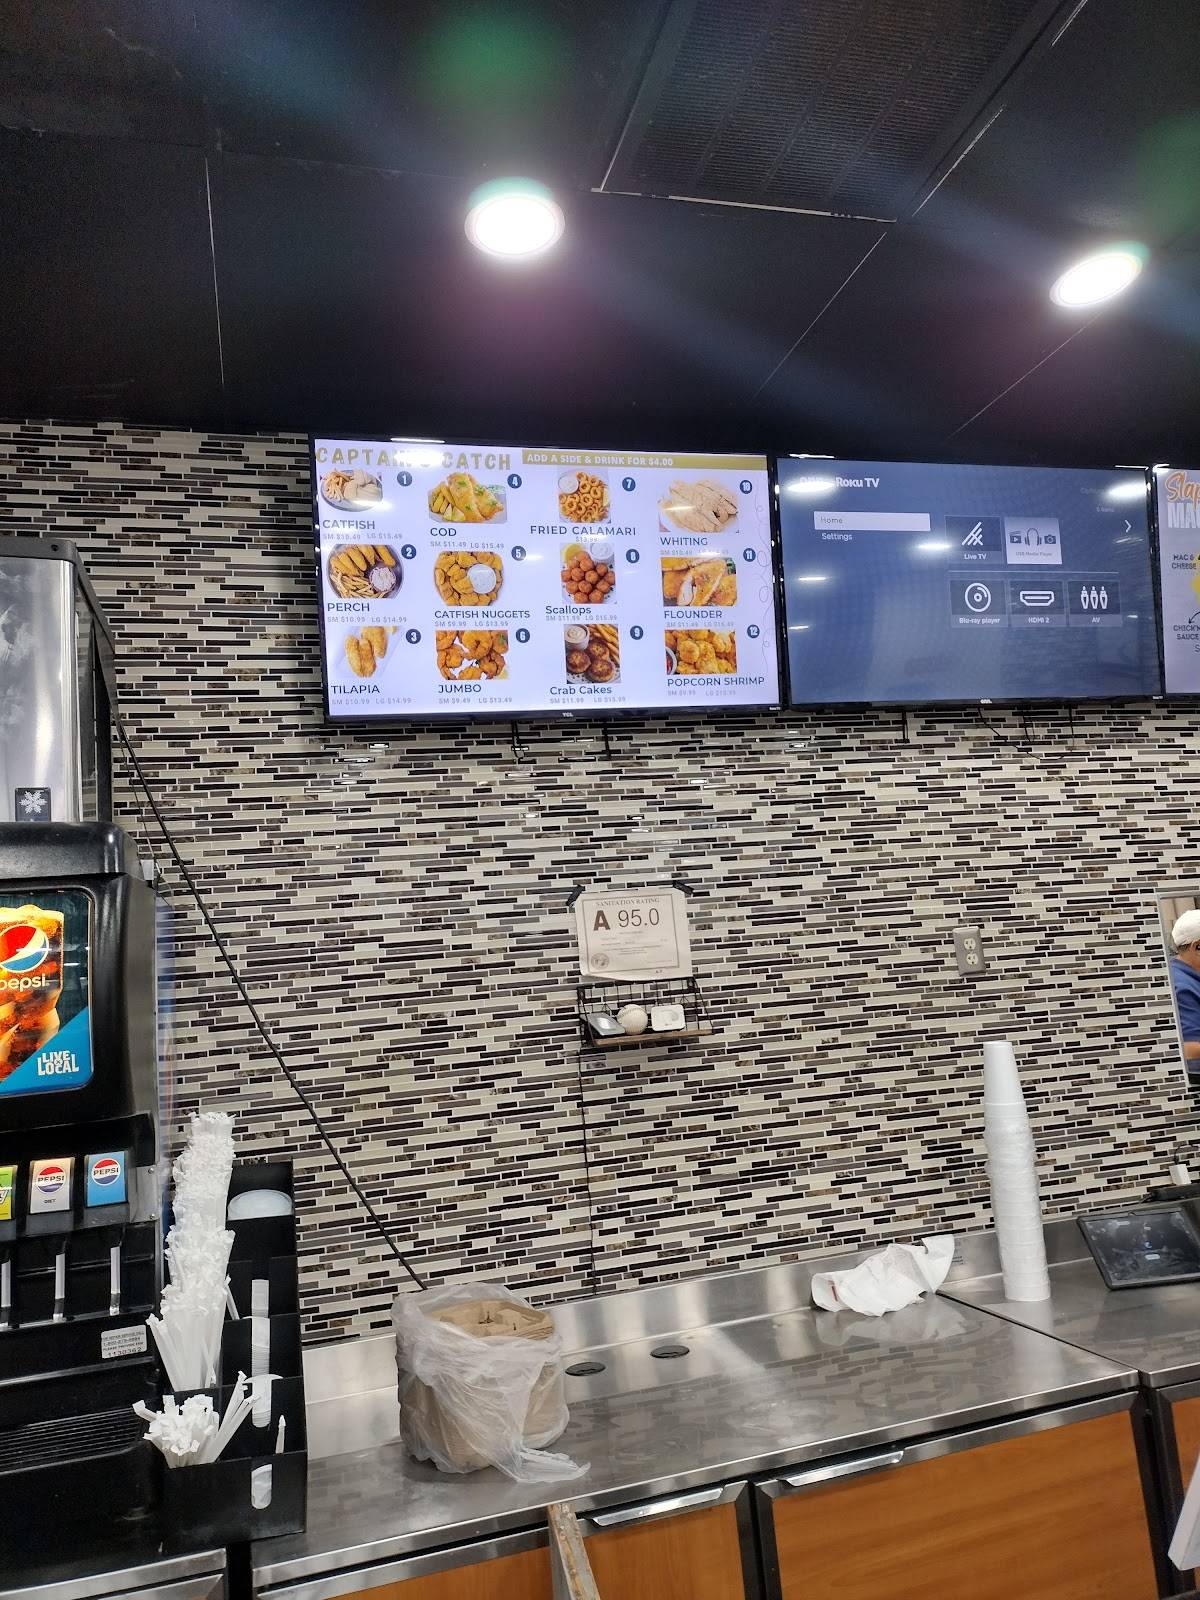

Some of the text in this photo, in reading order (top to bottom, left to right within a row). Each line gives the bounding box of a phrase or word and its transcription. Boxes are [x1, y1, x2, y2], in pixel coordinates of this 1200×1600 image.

[441, 451, 511, 471] CATCH
[527, 454, 673, 466] ADD A SIDE & DRINK FOR $4.00
[835, 476, 863, 488] Roku
[864, 477, 880, 488] TV
[322, 519, 375, 530] CATFISH
[820, 515, 843, 524] Home
[430, 527, 457, 537] COD
[530, 525, 636, 536] FRIED CALAMARI
[659, 537, 708, 546] WHITING
[821, 532, 853, 542] Settings
[1171, 562, 1196, 570] CHEESE
[327, 602, 370, 612] PERCH
[545, 605, 592, 616] Scallops
[434, 610, 530, 619] CATFISH NUGGETS
[663, 610, 723, 619] FLOUNDER
[959, 617, 1001, 625] Blu-ray player
[667, 676, 765, 687] POPCORN SHRIMP
[330, 684, 380, 694] TILAPIA
[438, 684, 482, 693] JUMBO
[549, 685, 613, 695] Crab Cakes
[595, 897, 660, 907] SANITATION RATING
[593, 907, 660, 931] A 95.0
[42, 1051, 71, 1064] LIVE
[37, 1053, 80, 1076] LOCAL
[93, 1168, 119, 1176] PEPSI
